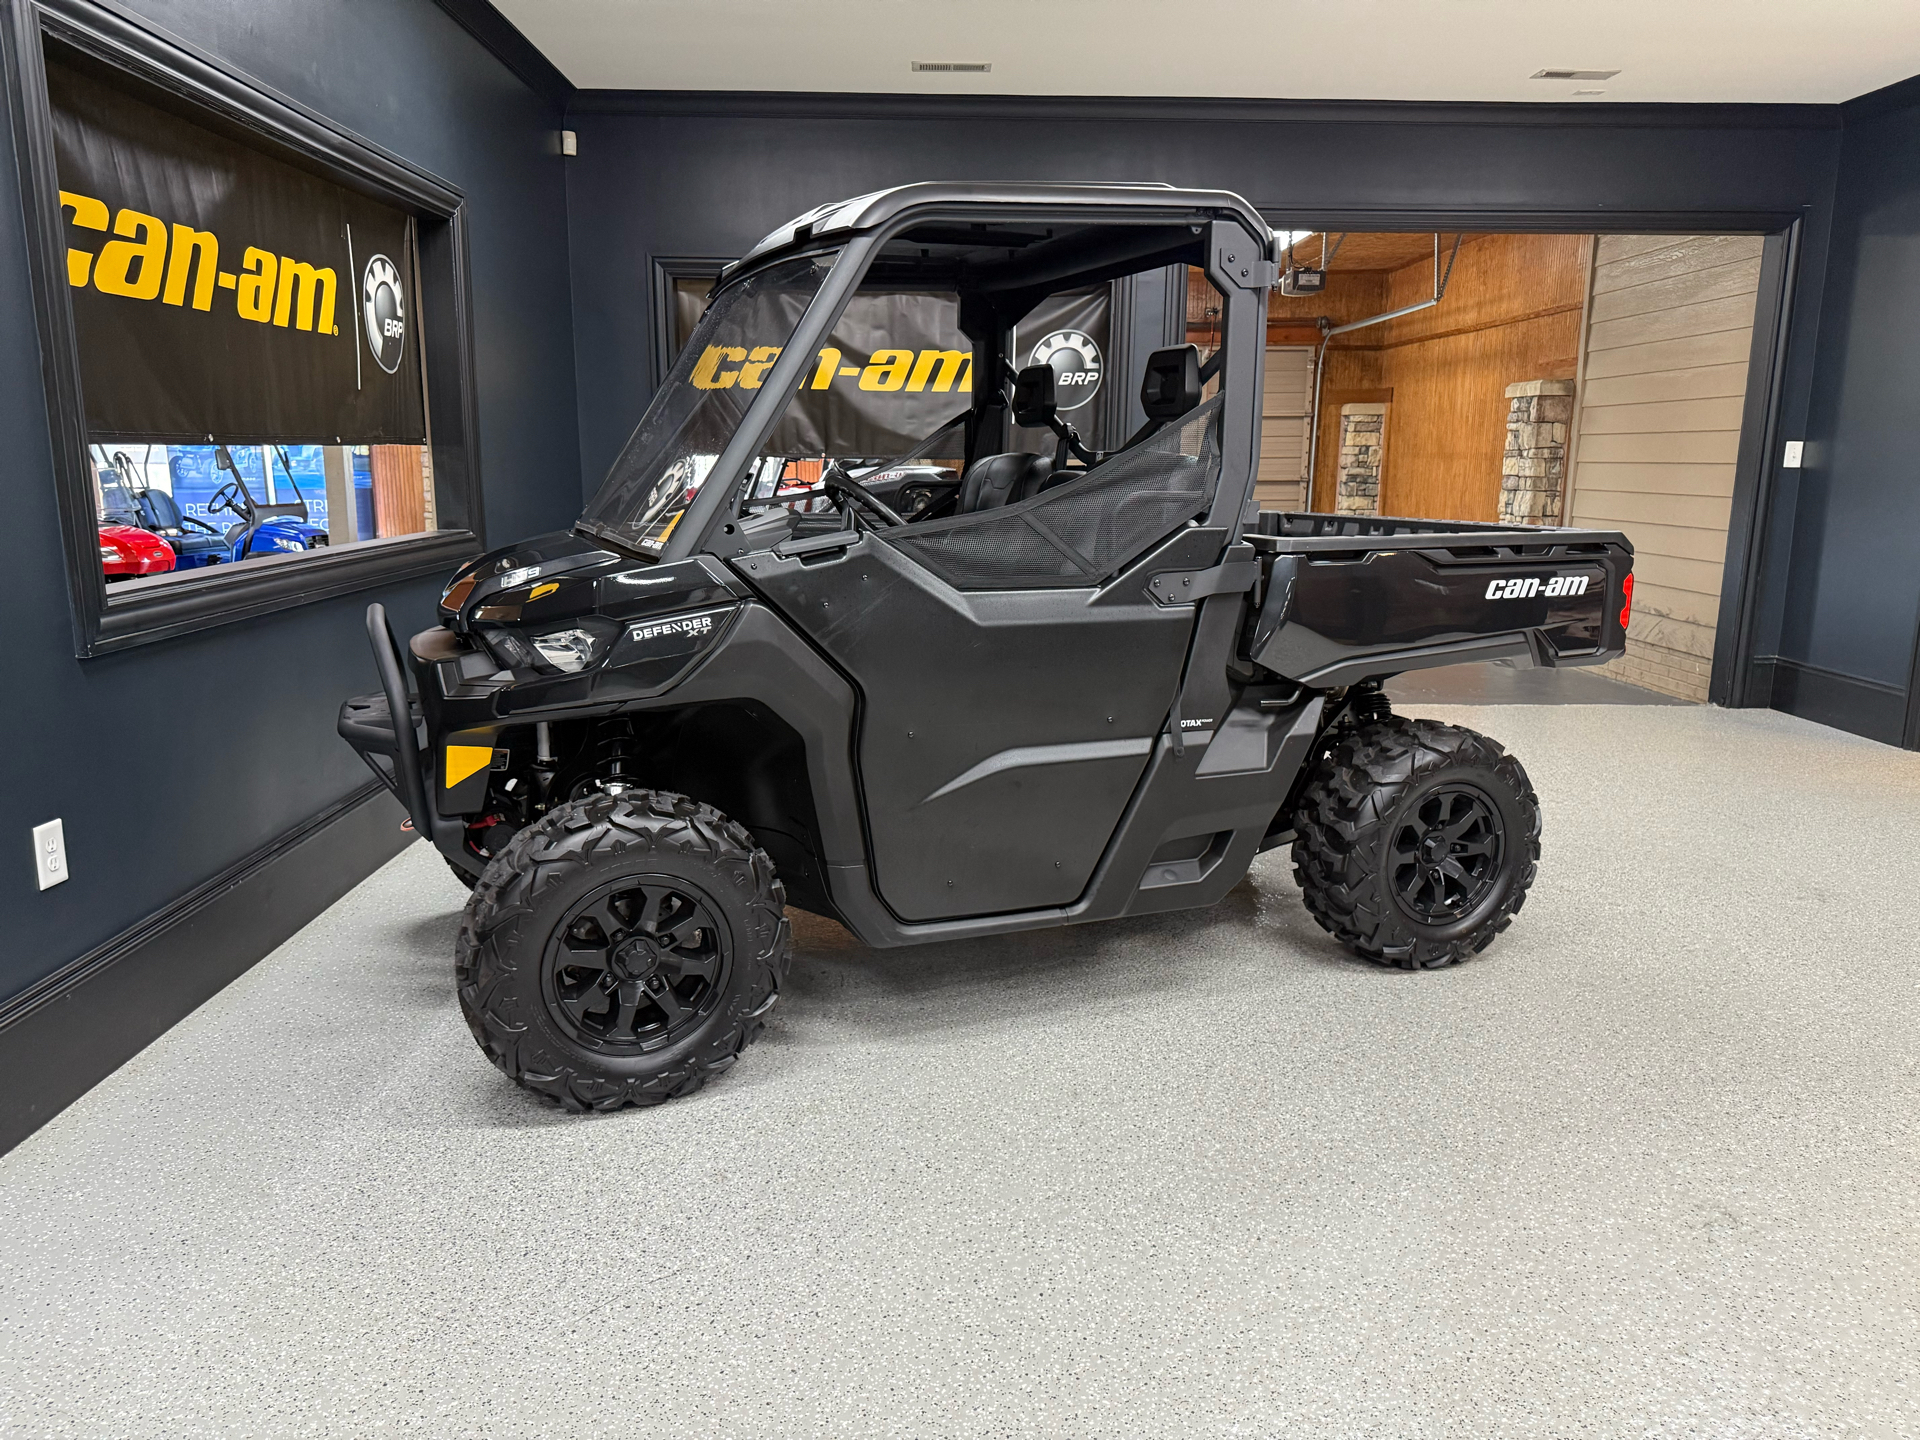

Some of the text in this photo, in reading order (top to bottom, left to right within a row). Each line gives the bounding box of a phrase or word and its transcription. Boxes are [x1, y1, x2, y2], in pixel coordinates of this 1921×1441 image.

[384, 318, 403, 338] BRP
[1058, 372, 1099, 385] BRP
[1485, 576, 1589, 600] can-am
[632, 617, 712, 641] DEFENDER
[686, 626, 712, 637] XT
[1181, 719, 1202, 728] OTAX
